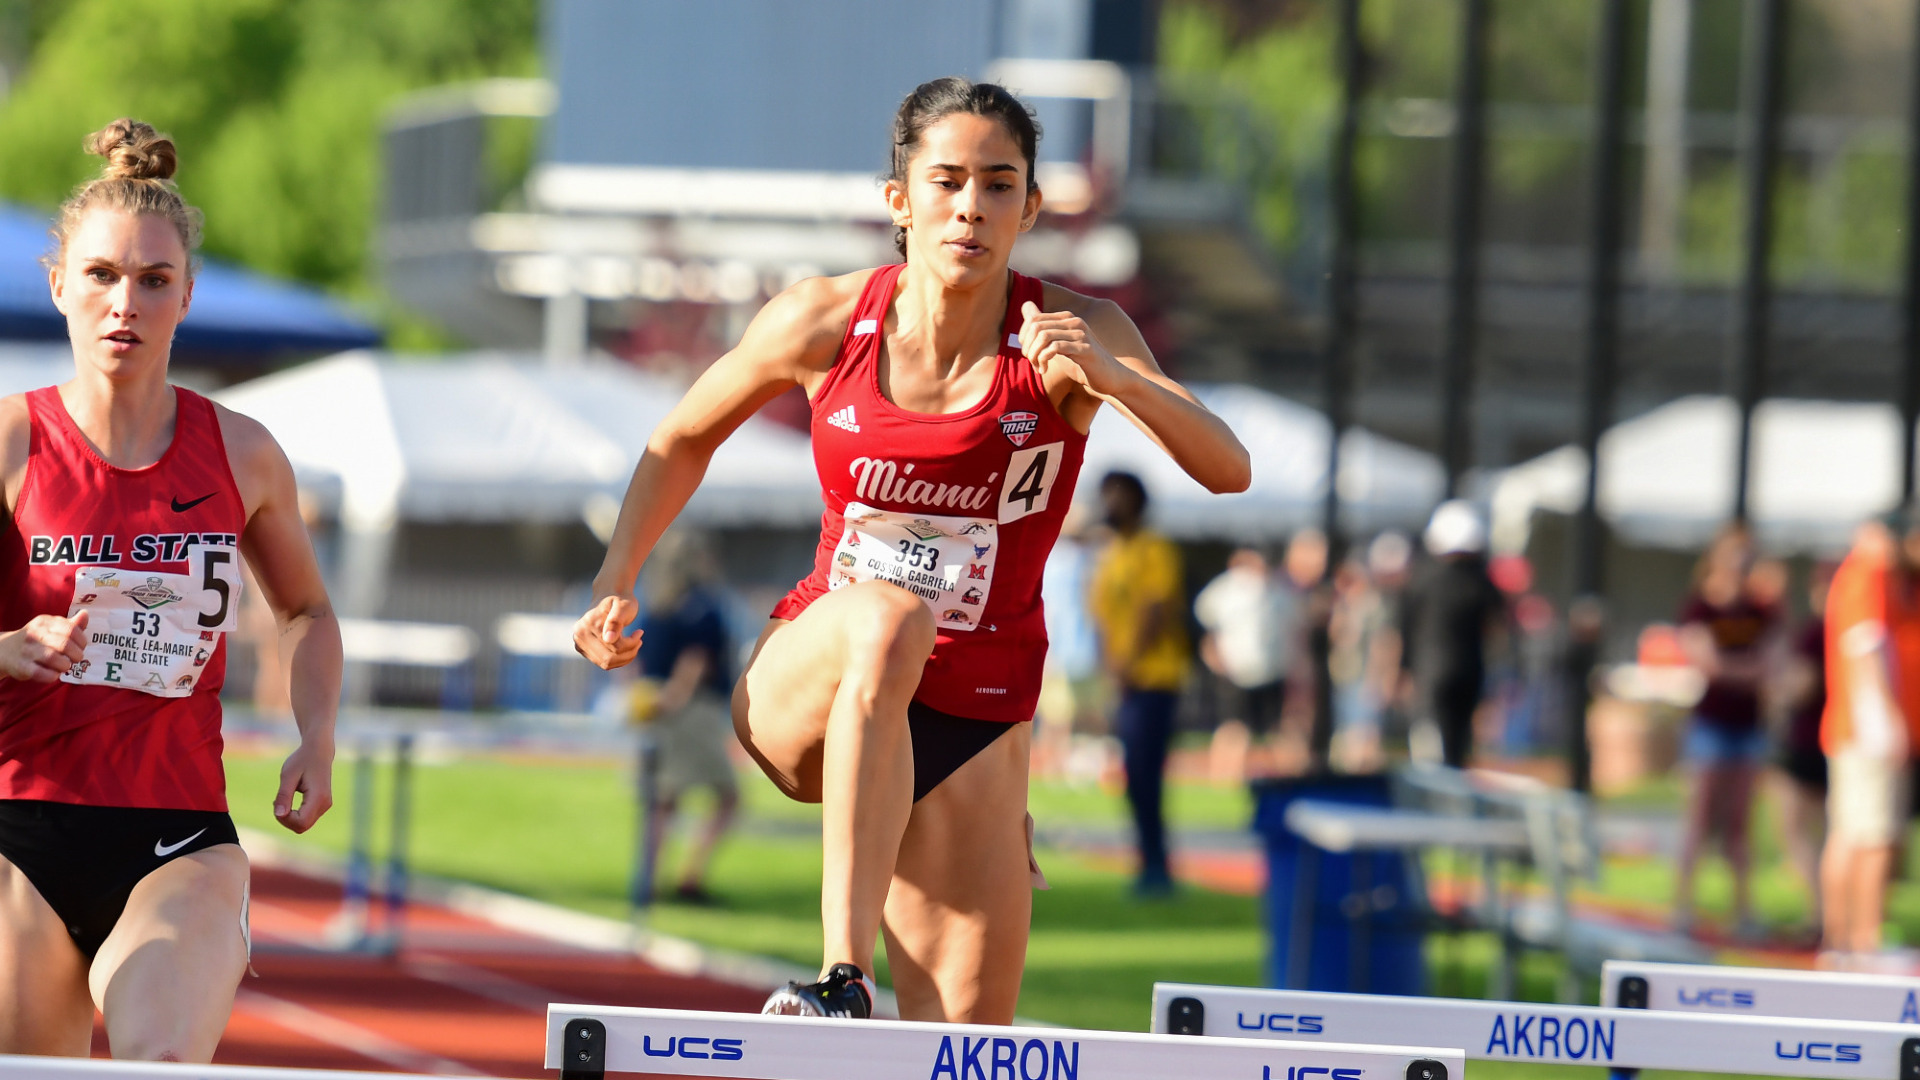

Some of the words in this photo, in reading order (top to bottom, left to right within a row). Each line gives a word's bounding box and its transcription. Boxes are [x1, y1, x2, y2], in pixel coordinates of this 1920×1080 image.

[827, 415, 860, 433] adidas
[1002, 421, 1036, 434] MAC
[849, 456, 998, 510] Miami
[1008, 450, 1048, 512] 4
[29, 535, 122, 565] BALL
[895, 539, 940, 571] 353
[198, 551, 230, 627] 5
[867, 558, 904, 579] COSSIO,
[908, 570, 955, 592] GABRIELA
[908, 583, 940, 602] (OHIO)
[131, 611, 160, 637] 53
[92, 632, 139, 651] DIEDICKE,
[142, 639, 193, 657] LEA-MARIE
[114, 648, 137, 663] BALL
[140, 652, 169, 667] STATE
[1678, 988, 1754, 1008] UCS
[1237, 1012, 1324, 1033] UCS
[1486, 1014, 1615, 1060] AKRON
[1775, 1040, 1862, 1062] UCS
[643, 1035, 744, 1061] UCS
[930, 1035, 1079, 1080] AKRON
